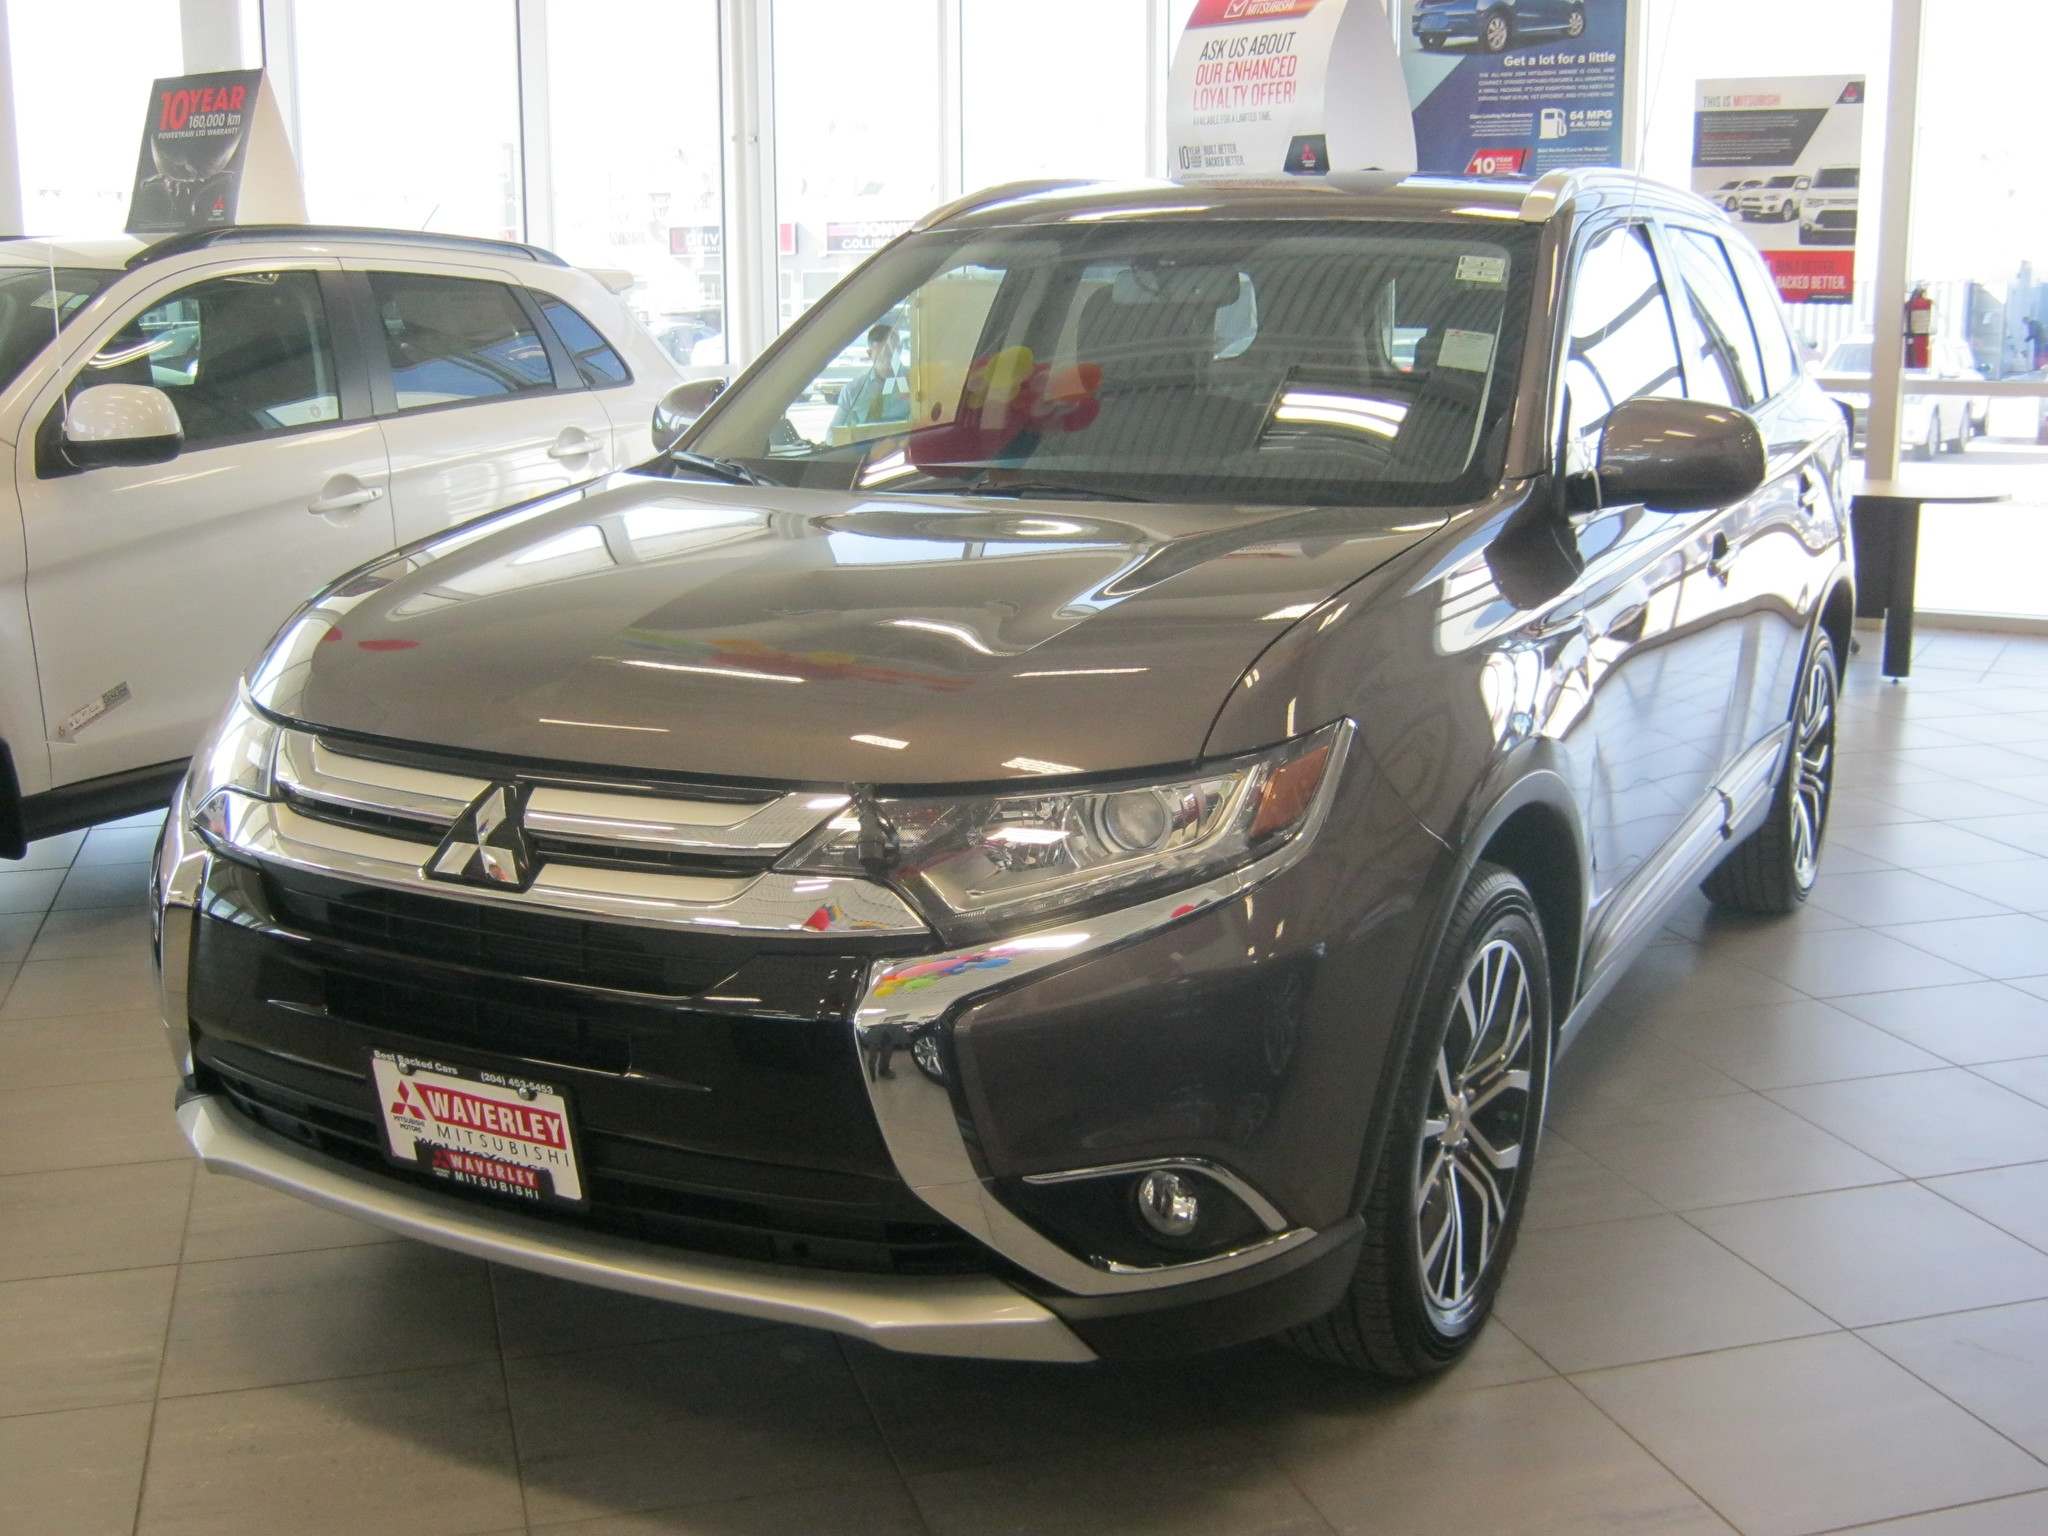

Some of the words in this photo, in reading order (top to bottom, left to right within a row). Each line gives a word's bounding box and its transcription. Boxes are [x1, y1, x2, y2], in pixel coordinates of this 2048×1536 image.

[1200, 41, 1227, 61] ASK
[1229, 37, 1248, 58] US
[1248, 32, 1296, 55] ABOUT
[1504, 55, 1525, 66] Get
[1529, 57, 1536, 65] a
[1539, 54, 1555, 65] lot
[1558, 53, 1574, 64] for
[1578, 55, 1585, 63] a
[1588, 52, 1616, 63] little
[1195, 62, 1223, 86] OUR
[1225, 55, 1297, 81] ENHANCED
[159, 88, 189, 130] 10
[189, 84, 247, 113] YEAR
[1193, 83, 1248, 111] LOYALTY
[1251, 80, 1296, 106] OFFER!
[189, 114, 224, 129] 160,000
[227, 113, 241, 126] km
[1569, 111, 1584, 121] 64
[1587, 110, 1613, 120] MPG
[1178, 145, 1191, 170] 10
[1472, 157, 1496, 174] 10
[374, 1050, 396, 1062] Best
[398, 1055, 433, 1071] Backed
[434, 1062, 458, 1075] Cars
[480, 1071, 506, 1087] (204)
[400, 1123, 422, 1134] MOTORS
[426, 1089, 561, 1145] WAVERLEY
[436, 1123, 569, 1167] MITSUBISHI
[449, 1153, 536, 1187] WAVERLEY
[454, 1171, 540, 1200] MITSUBISHI
